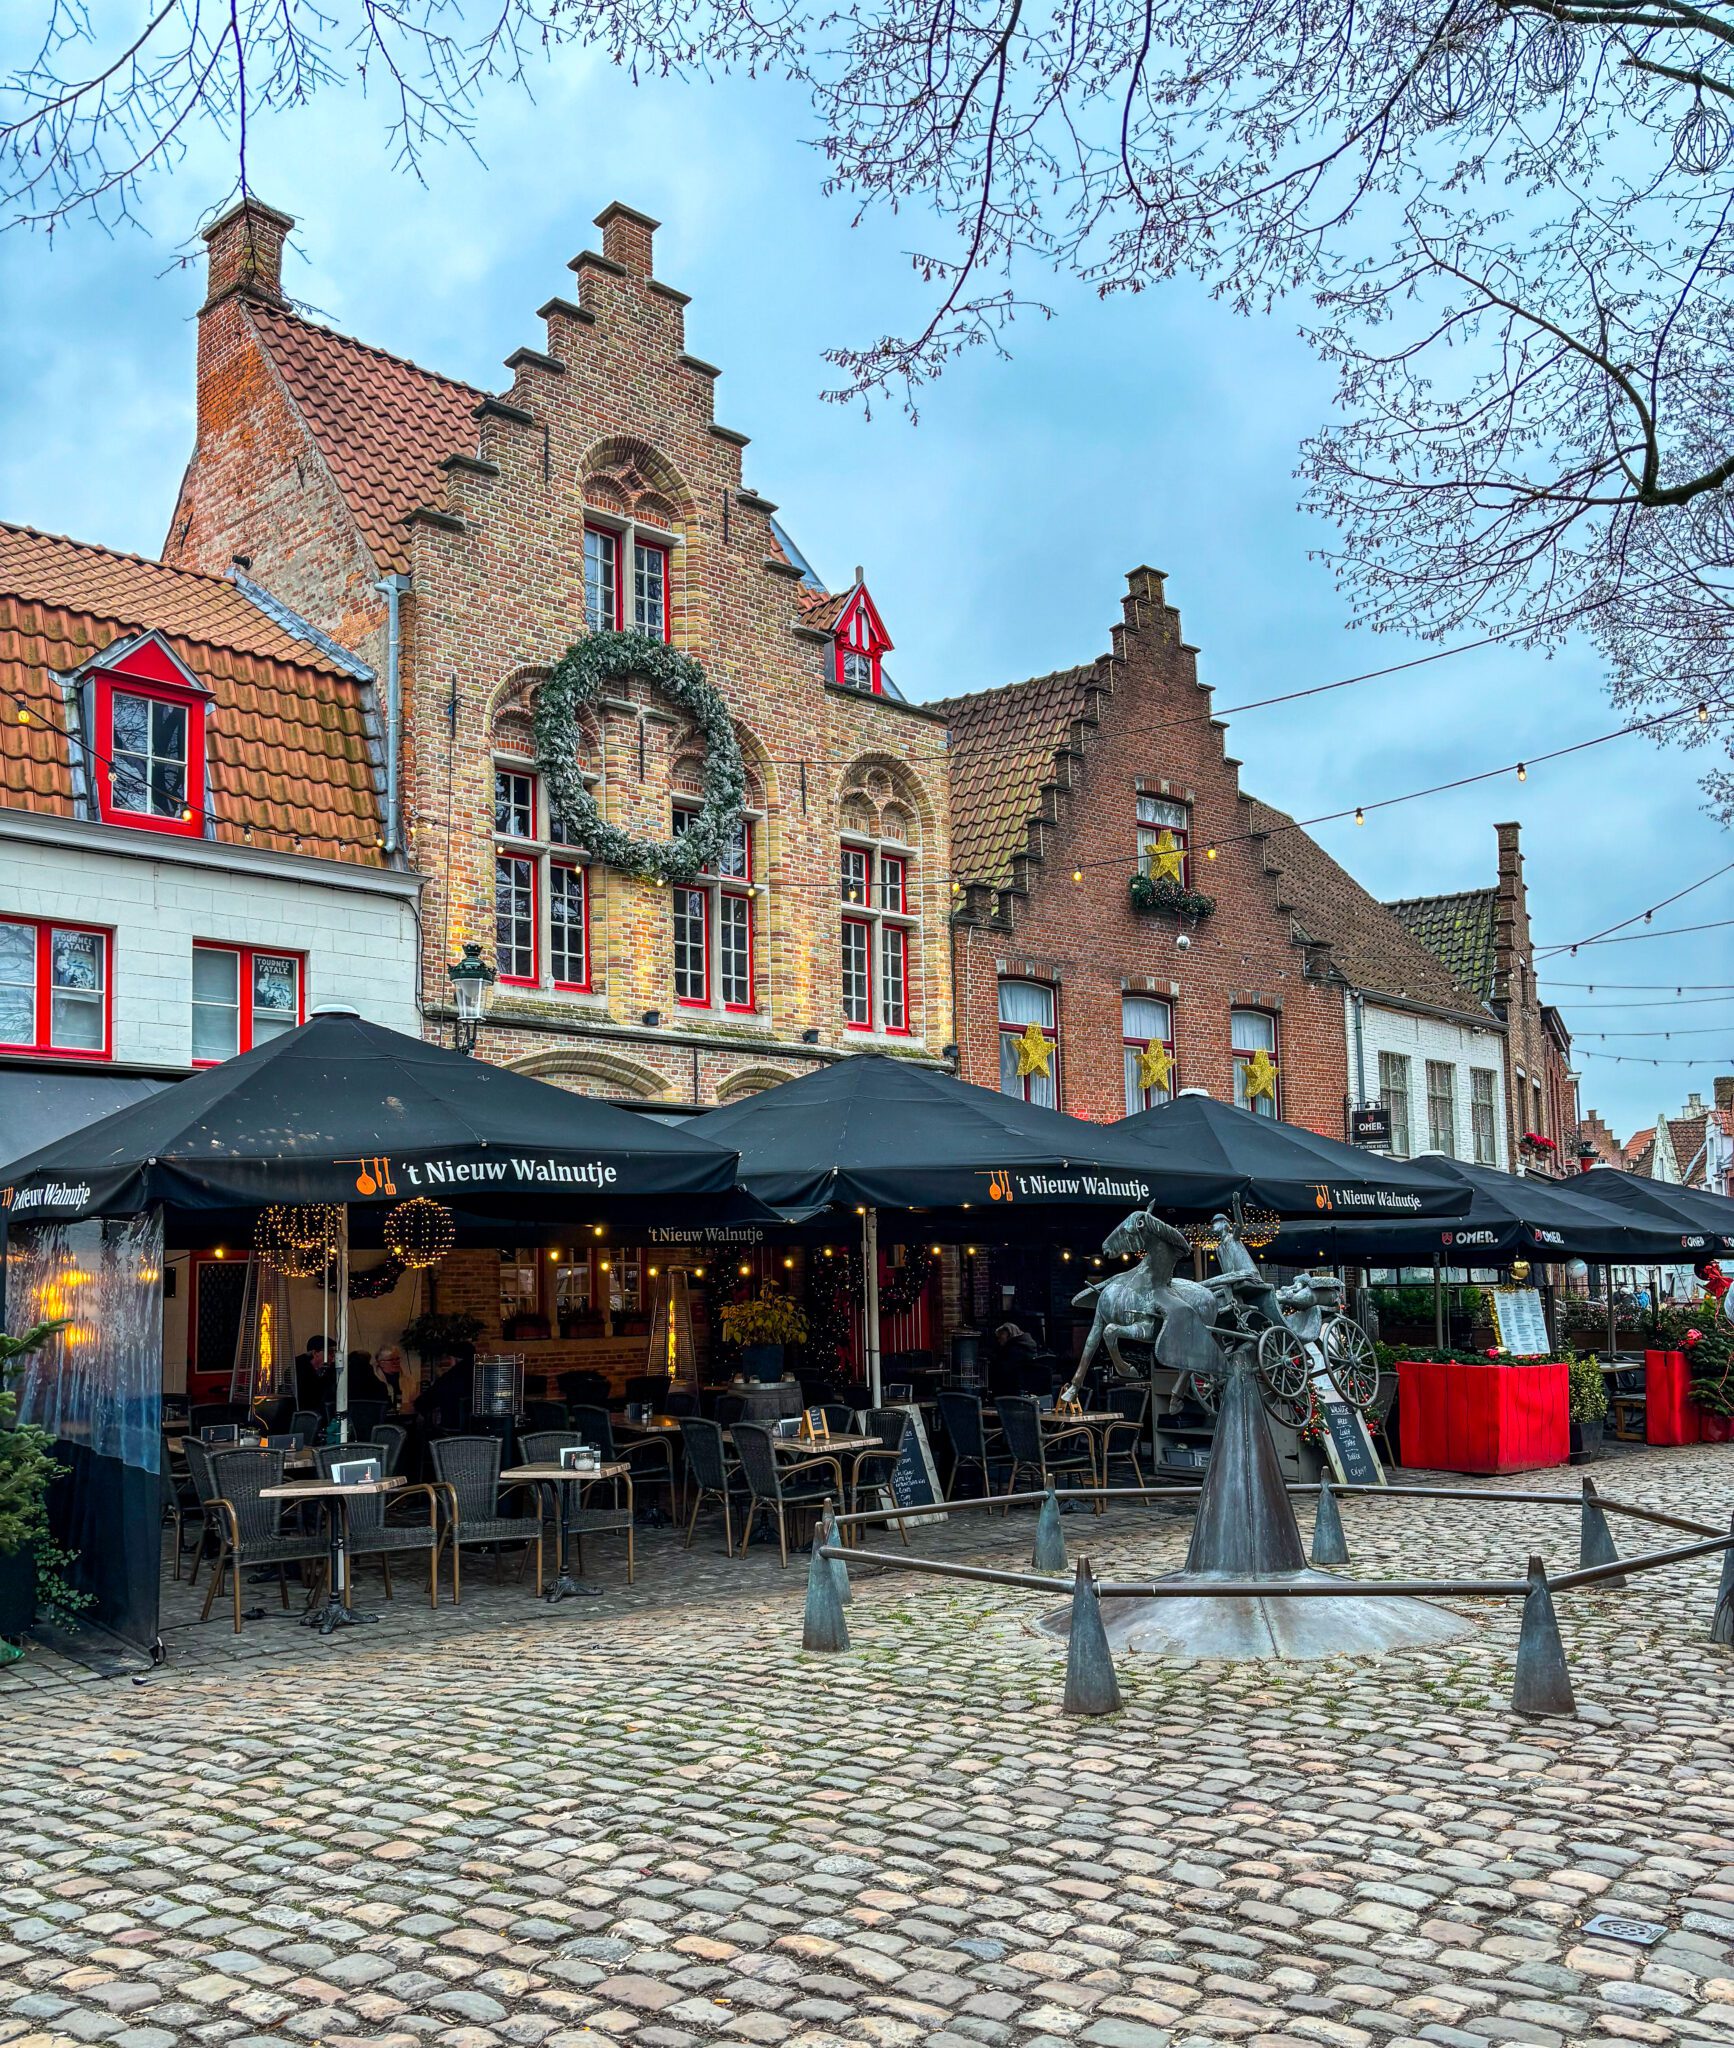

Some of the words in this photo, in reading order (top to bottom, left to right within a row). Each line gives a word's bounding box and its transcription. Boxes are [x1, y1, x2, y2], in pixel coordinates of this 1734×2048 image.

[58, 941, 91, 952] FATALE
[259, 965, 288, 974] FATALE
[1359, 1122, 1385, 1131] OMER.
[402, 1163, 421, 1184] 't
[425, 1160, 507, 1184] Nieuw
[511, 1159, 617, 1188] Walnutje
[44, 1181, 90, 1211] Walnutje
[1016, 1175, 1028, 1194] 't
[1029, 1175, 1080, 1194] Nieuw
[1081, 1176, 1150, 1202] Walnutje
[1333, 1189, 1342, 1204] 't
[1342, 1189, 1375, 1205] Nieuw
[1377, 1191, 1422, 1211] Walnutje
[659, 1227, 703, 1242] Nieuw
[705, 1227, 763, 1245] Walnutje
[1456, 1230, 1499, 1244] OMER.
